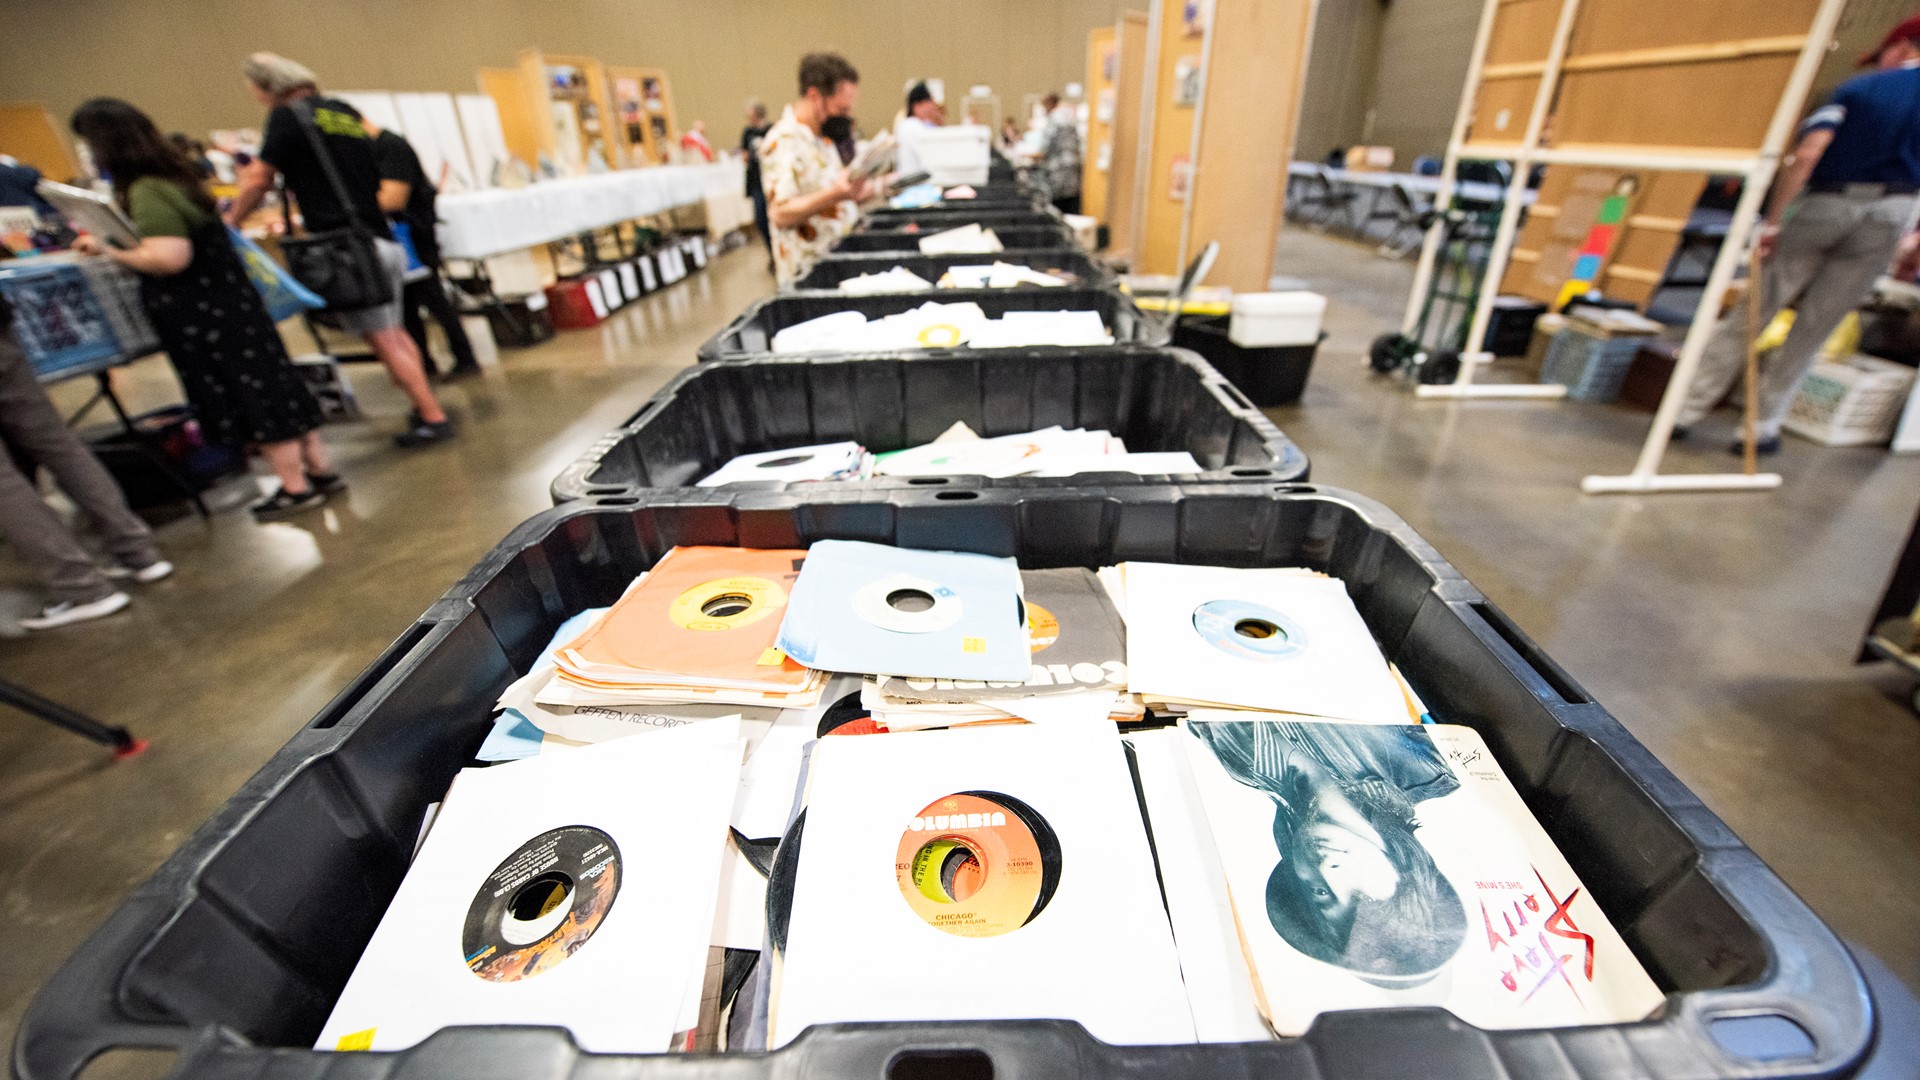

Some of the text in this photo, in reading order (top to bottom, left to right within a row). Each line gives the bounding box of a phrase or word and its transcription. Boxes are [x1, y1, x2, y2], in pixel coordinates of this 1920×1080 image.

[574, 705, 694, 728] GEFFEN RECORD
[907, 812, 1006, 832] OLUMBIA
[538, 855, 559, 871] HOUSE
[579, 854, 614, 880] RECORDS
[917, 864, 927, 876] THE
[509, 872, 531, 888] CARDS
[1474, 880, 1524, 890] SHE'S MINE
[1479, 863, 1581, 953] Perry
[1500, 887, 1595, 1013] Steve
